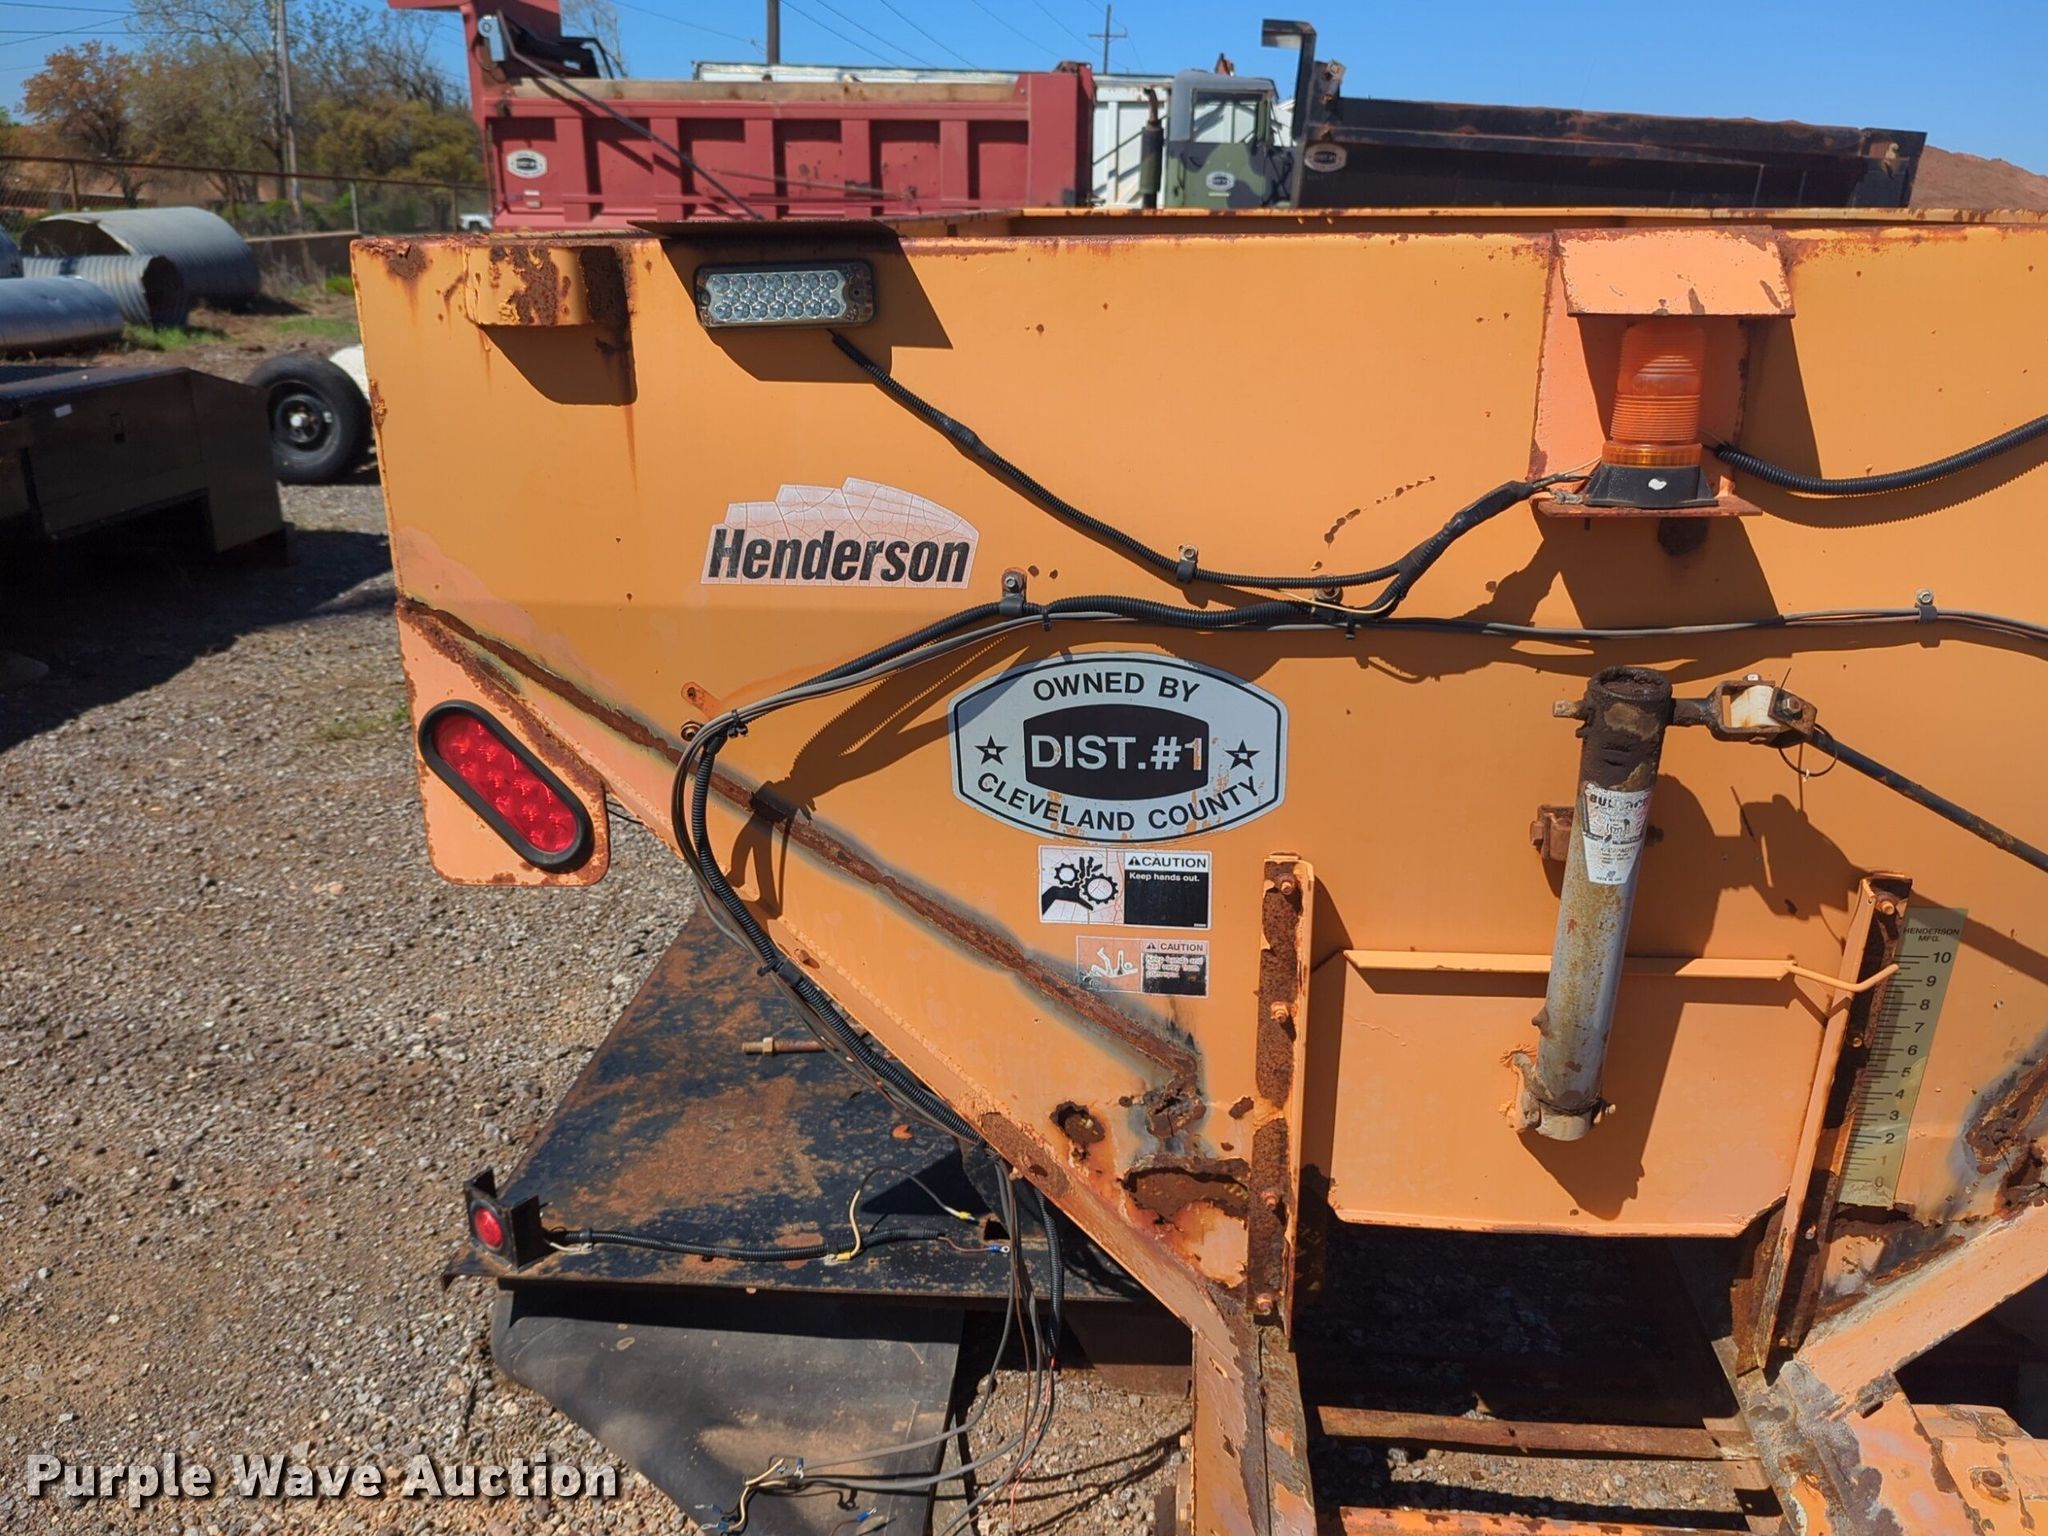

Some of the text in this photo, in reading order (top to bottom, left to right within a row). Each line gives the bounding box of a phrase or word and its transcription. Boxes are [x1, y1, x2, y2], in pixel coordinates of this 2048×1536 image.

[708, 529, 971, 583] Henderson
[1033, 672, 1199, 702] OWNED BY
[1031, 734, 1203, 771] DIST.#1
[977, 772, 1258, 831] CLEVELAND COUNTY
[1142, 856, 1207, 868] CAUTION
[1129, 872, 1200, 882] Keep hands out.
[1903, 927, 1960, 936] HENDERSON
[1160, 943, 1203, 951] CAUTION
[1933, 951, 1952, 964] 10
[1926, 975, 1937, 987] 9
[1919, 999, 1931, 1011] 8
[1913, 1022, 1925, 1033] 7
[1907, 1045, 1918, 1056] 6
[1901, 1067, 1912, 1078] 5
[1895, 1089, 1905, 1100] 4
[1889, 1110, 1900, 1121] 3
[1884, 1133, 1896, 1144] 2
[1881, 1155, 1888, 1166] 1
[1875, 1176, 1884, 1188] 0
